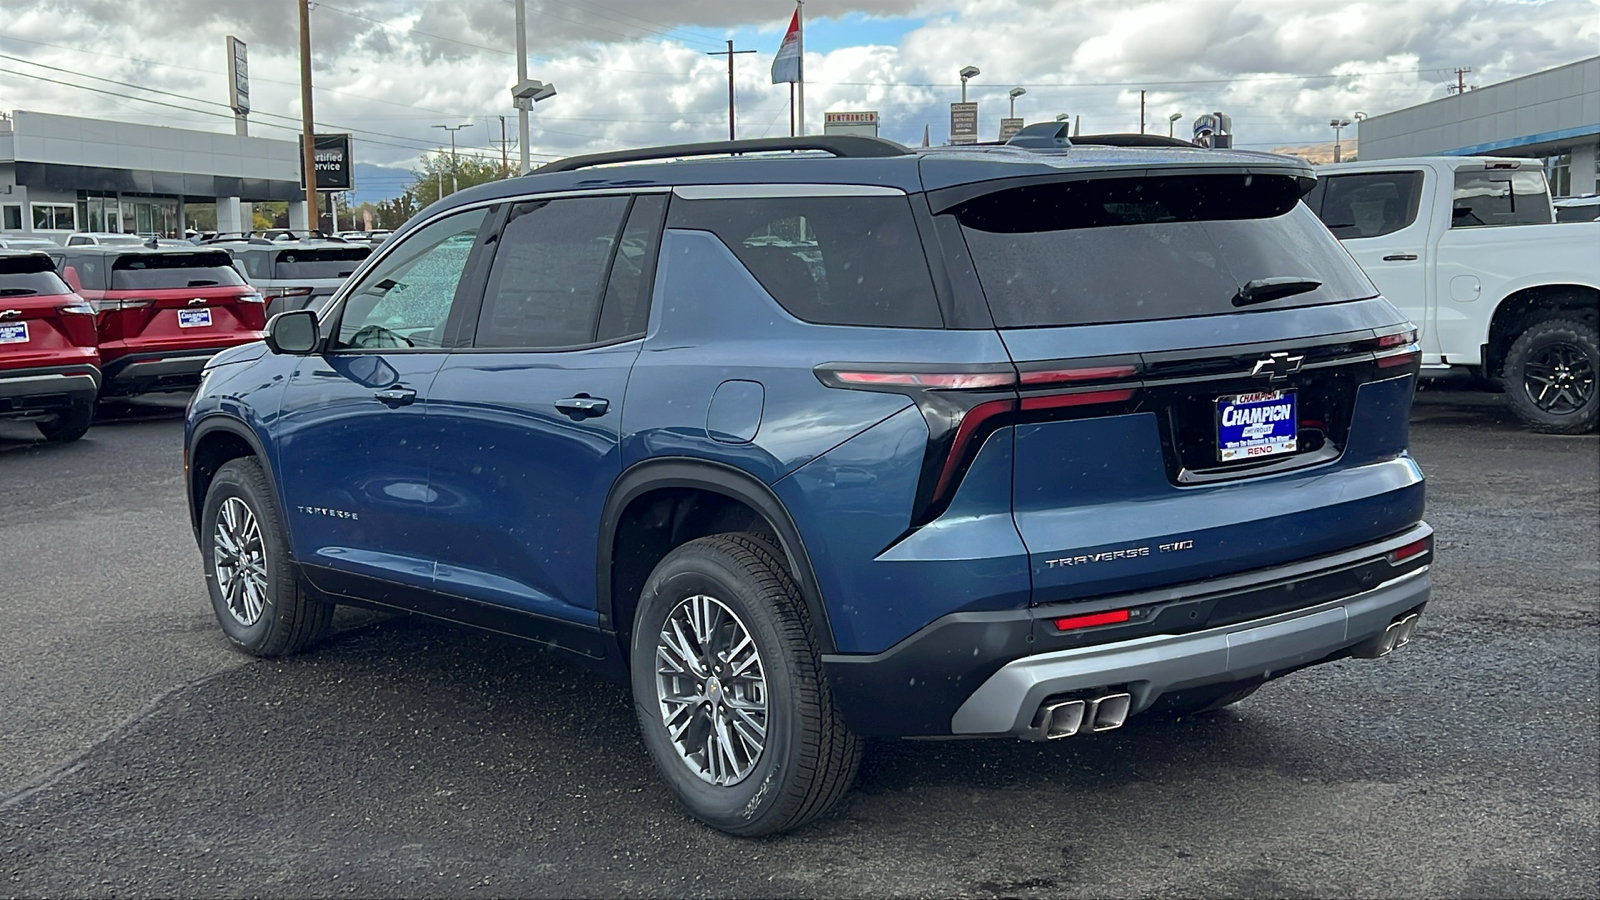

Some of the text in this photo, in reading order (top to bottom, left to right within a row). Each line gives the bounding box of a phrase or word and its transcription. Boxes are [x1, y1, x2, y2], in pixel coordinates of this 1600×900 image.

[314, 161, 341, 171] ervice
[1239, 390, 1278, 404] CHAMPION
[1222, 403, 1292, 427] CHAMPION
[1244, 425, 1272, 435] CHEVROLET
[1247, 445, 1273, 455] RENO
[297, 505, 358, 520] TRAVERSE
[1045, 540, 1193, 569] TRAVERSE AWD
